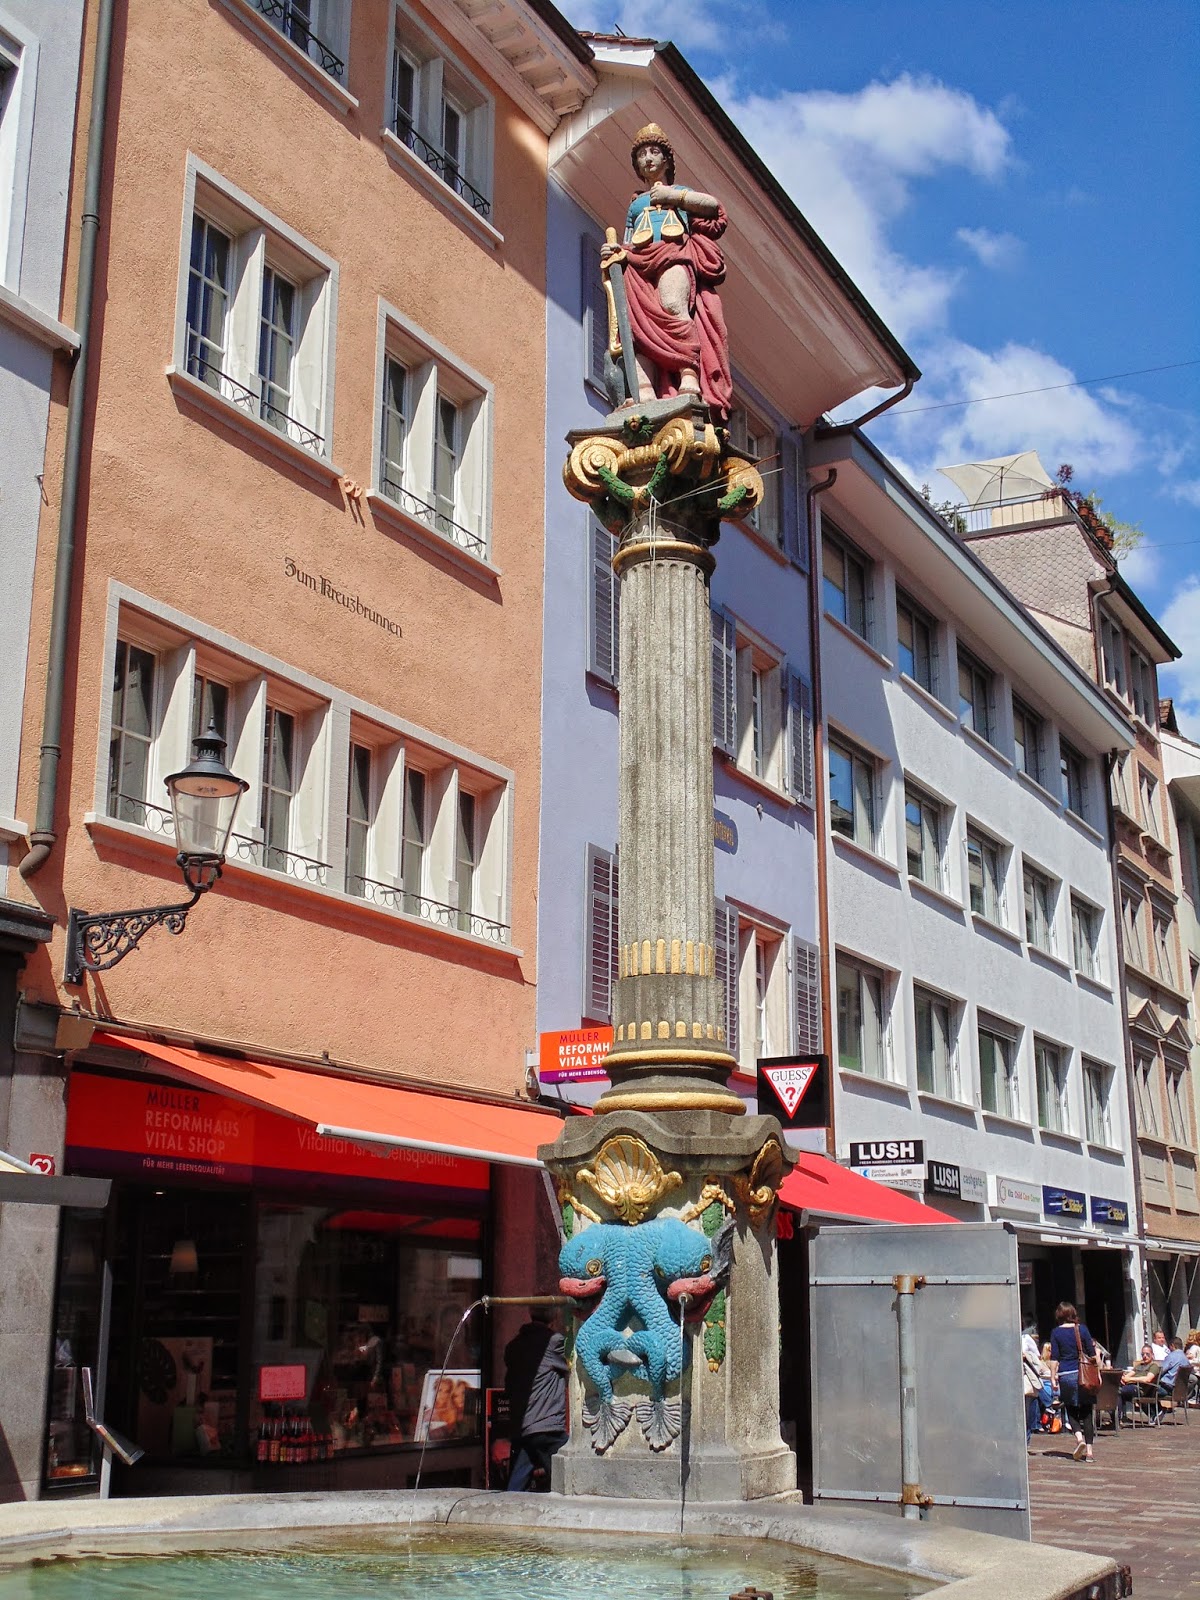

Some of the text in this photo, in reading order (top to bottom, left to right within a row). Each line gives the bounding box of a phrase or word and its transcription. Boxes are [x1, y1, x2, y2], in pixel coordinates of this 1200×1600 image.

[284, 556, 403, 638] Zum Kreuzbrunnen
[560, 1031, 599, 1043] MÜLLER
[559, 1042, 610, 1056] REFORMH
[559, 1054, 606, 1067] VITAL SH
[147, 1087, 200, 1111] MÜLLER
[145, 1110, 240, 1138] REFORMHAUS
[145, 1131, 225, 1156] VITAL SHOP
[858, 1142, 915, 1160] LUSH
[143, 1158, 225, 1175] FÜR MEHR LEBENSQUALITÄT
[933, 1165, 959, 1189] LUSH
